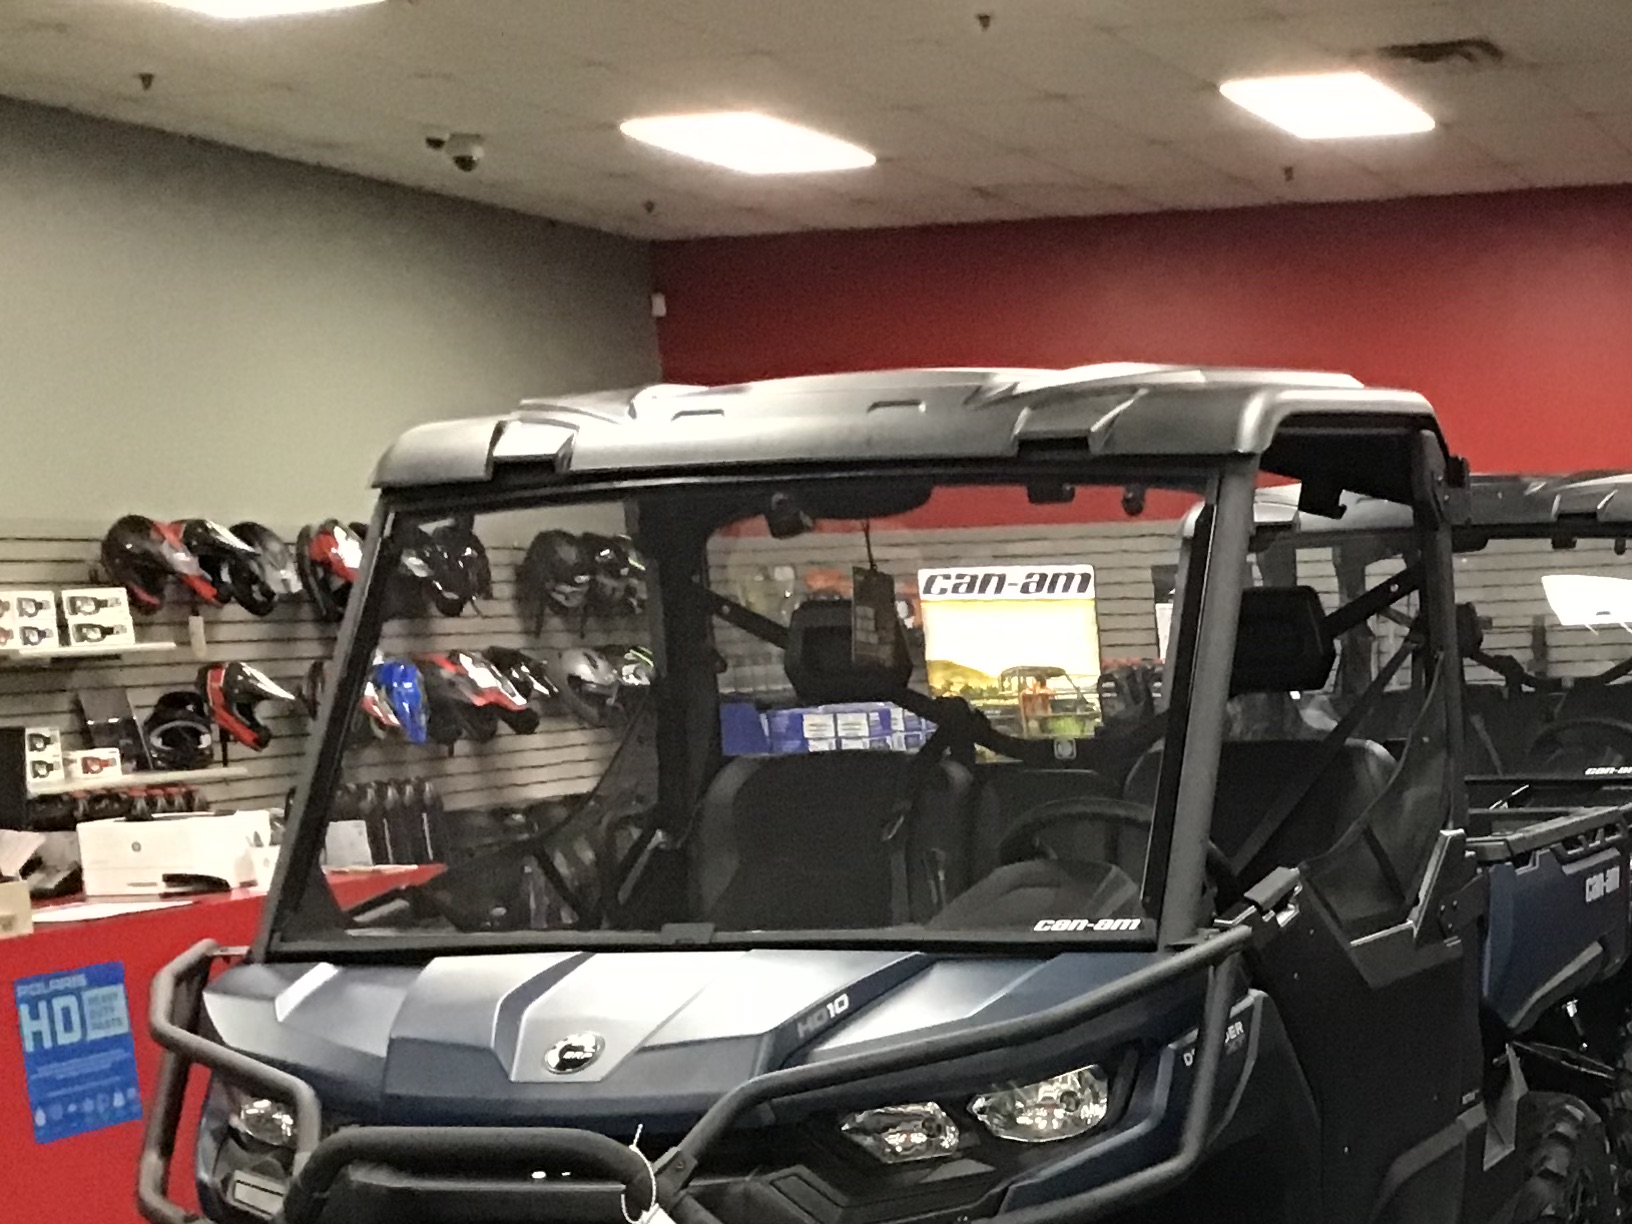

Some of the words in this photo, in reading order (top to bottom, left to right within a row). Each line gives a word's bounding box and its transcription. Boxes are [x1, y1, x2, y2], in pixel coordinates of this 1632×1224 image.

[922, 570, 1092, 597] can-am
[1033, 917, 1142, 933] can-am
[20, 994, 82, 1053] HD
[797, 992, 850, 1039] HD10
